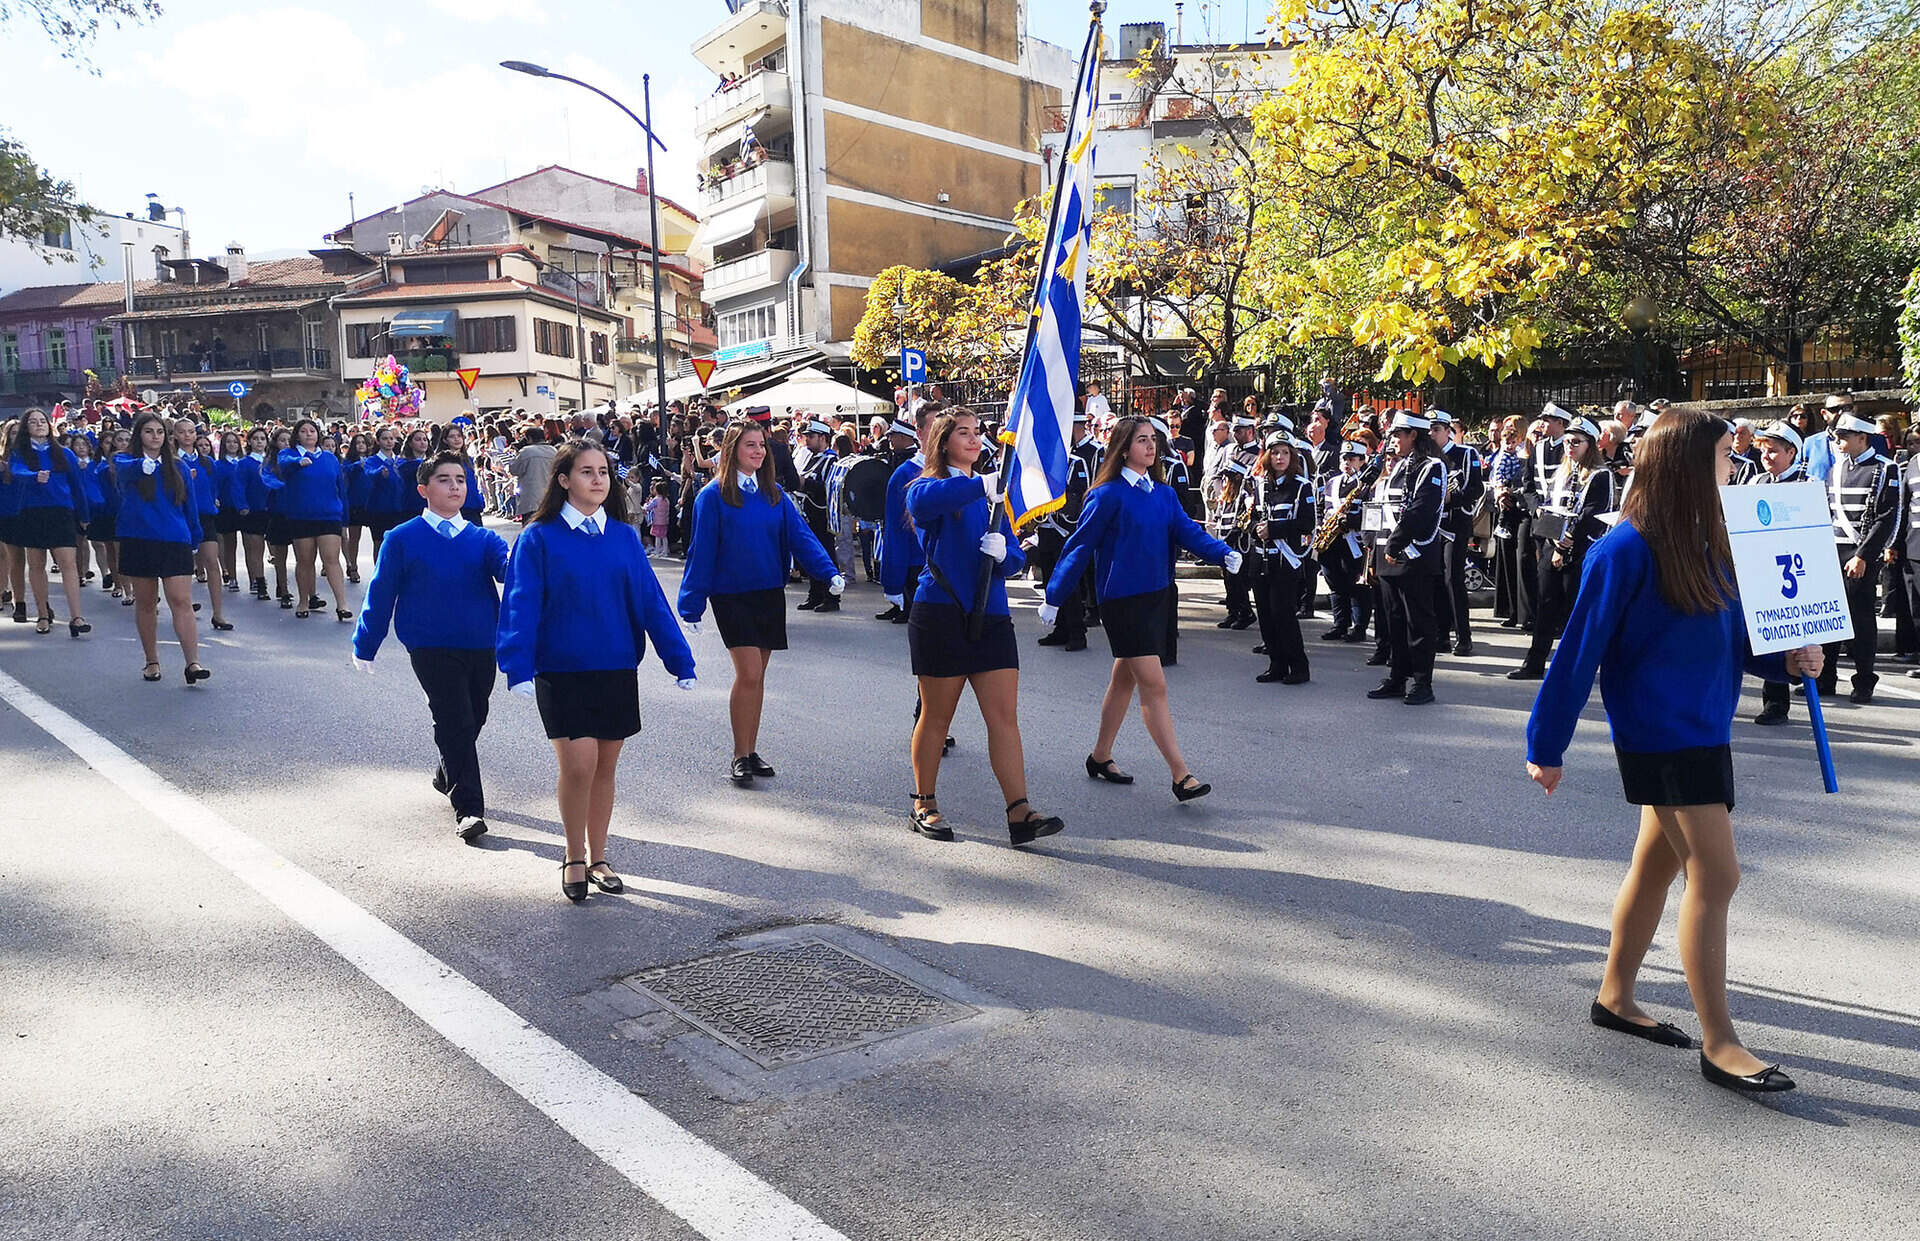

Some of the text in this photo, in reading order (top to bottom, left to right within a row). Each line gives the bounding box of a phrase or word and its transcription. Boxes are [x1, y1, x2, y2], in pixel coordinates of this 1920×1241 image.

[906, 352, 922, 378] P
[1755, 599, 1840, 624] ΓΥΜΝΑΣΙΟ ΝΑΟΥΣΑΣ
